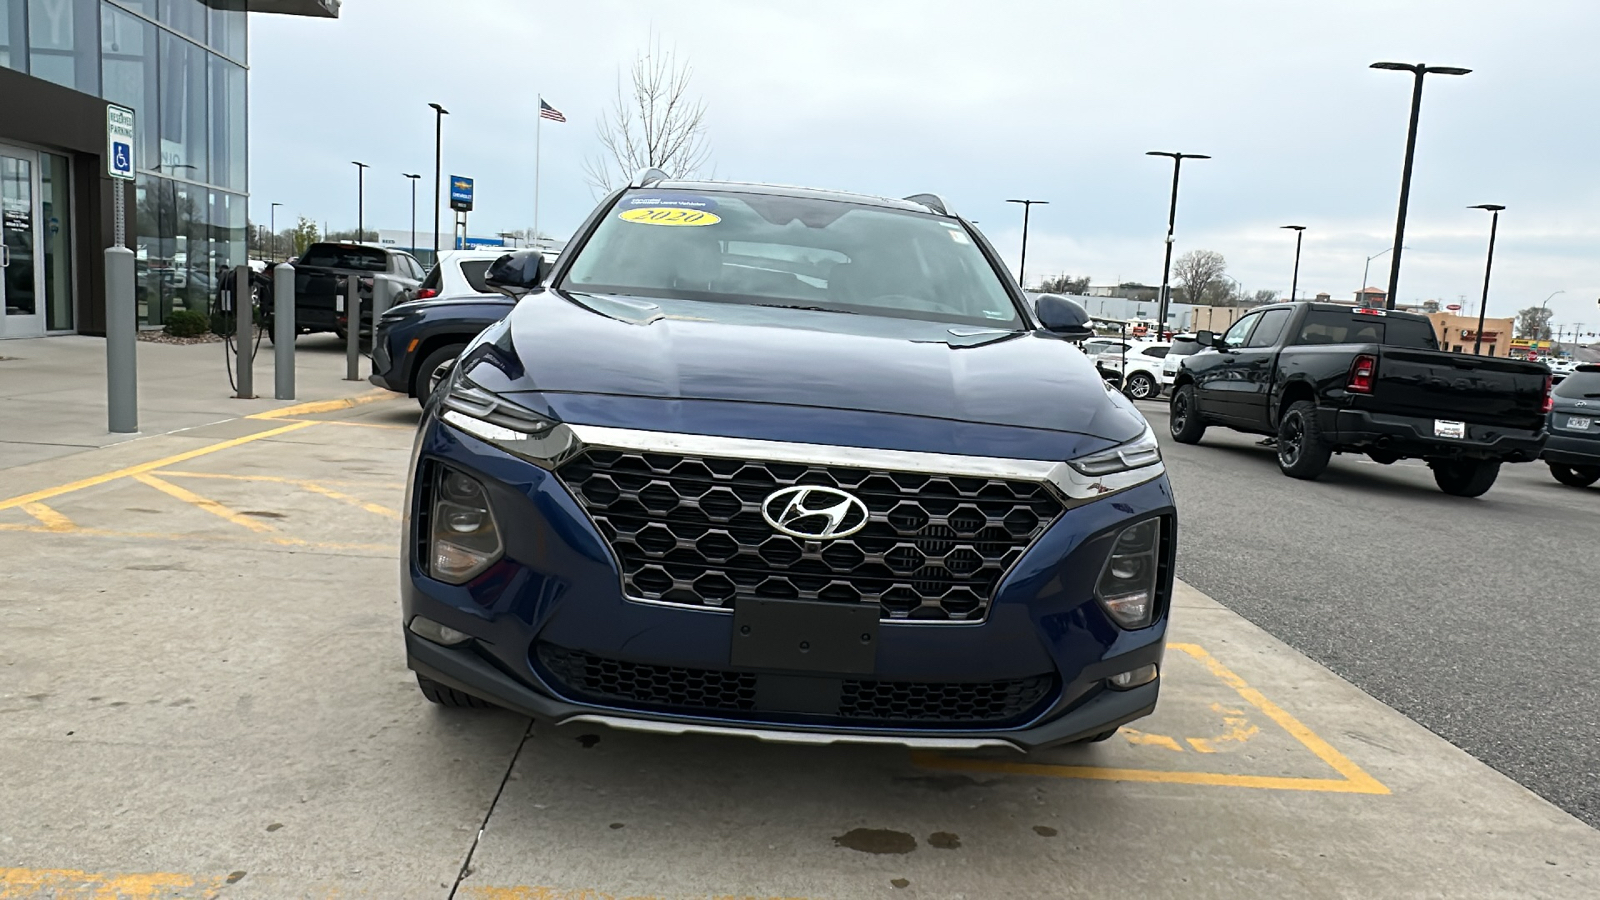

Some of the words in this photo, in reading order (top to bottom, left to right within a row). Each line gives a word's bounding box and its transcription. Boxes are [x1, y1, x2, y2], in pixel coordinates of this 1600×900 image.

[110, 112, 132, 127] RESERVED
[110, 124, 133, 138] PARKING
[632, 210, 704, 222] 2020
